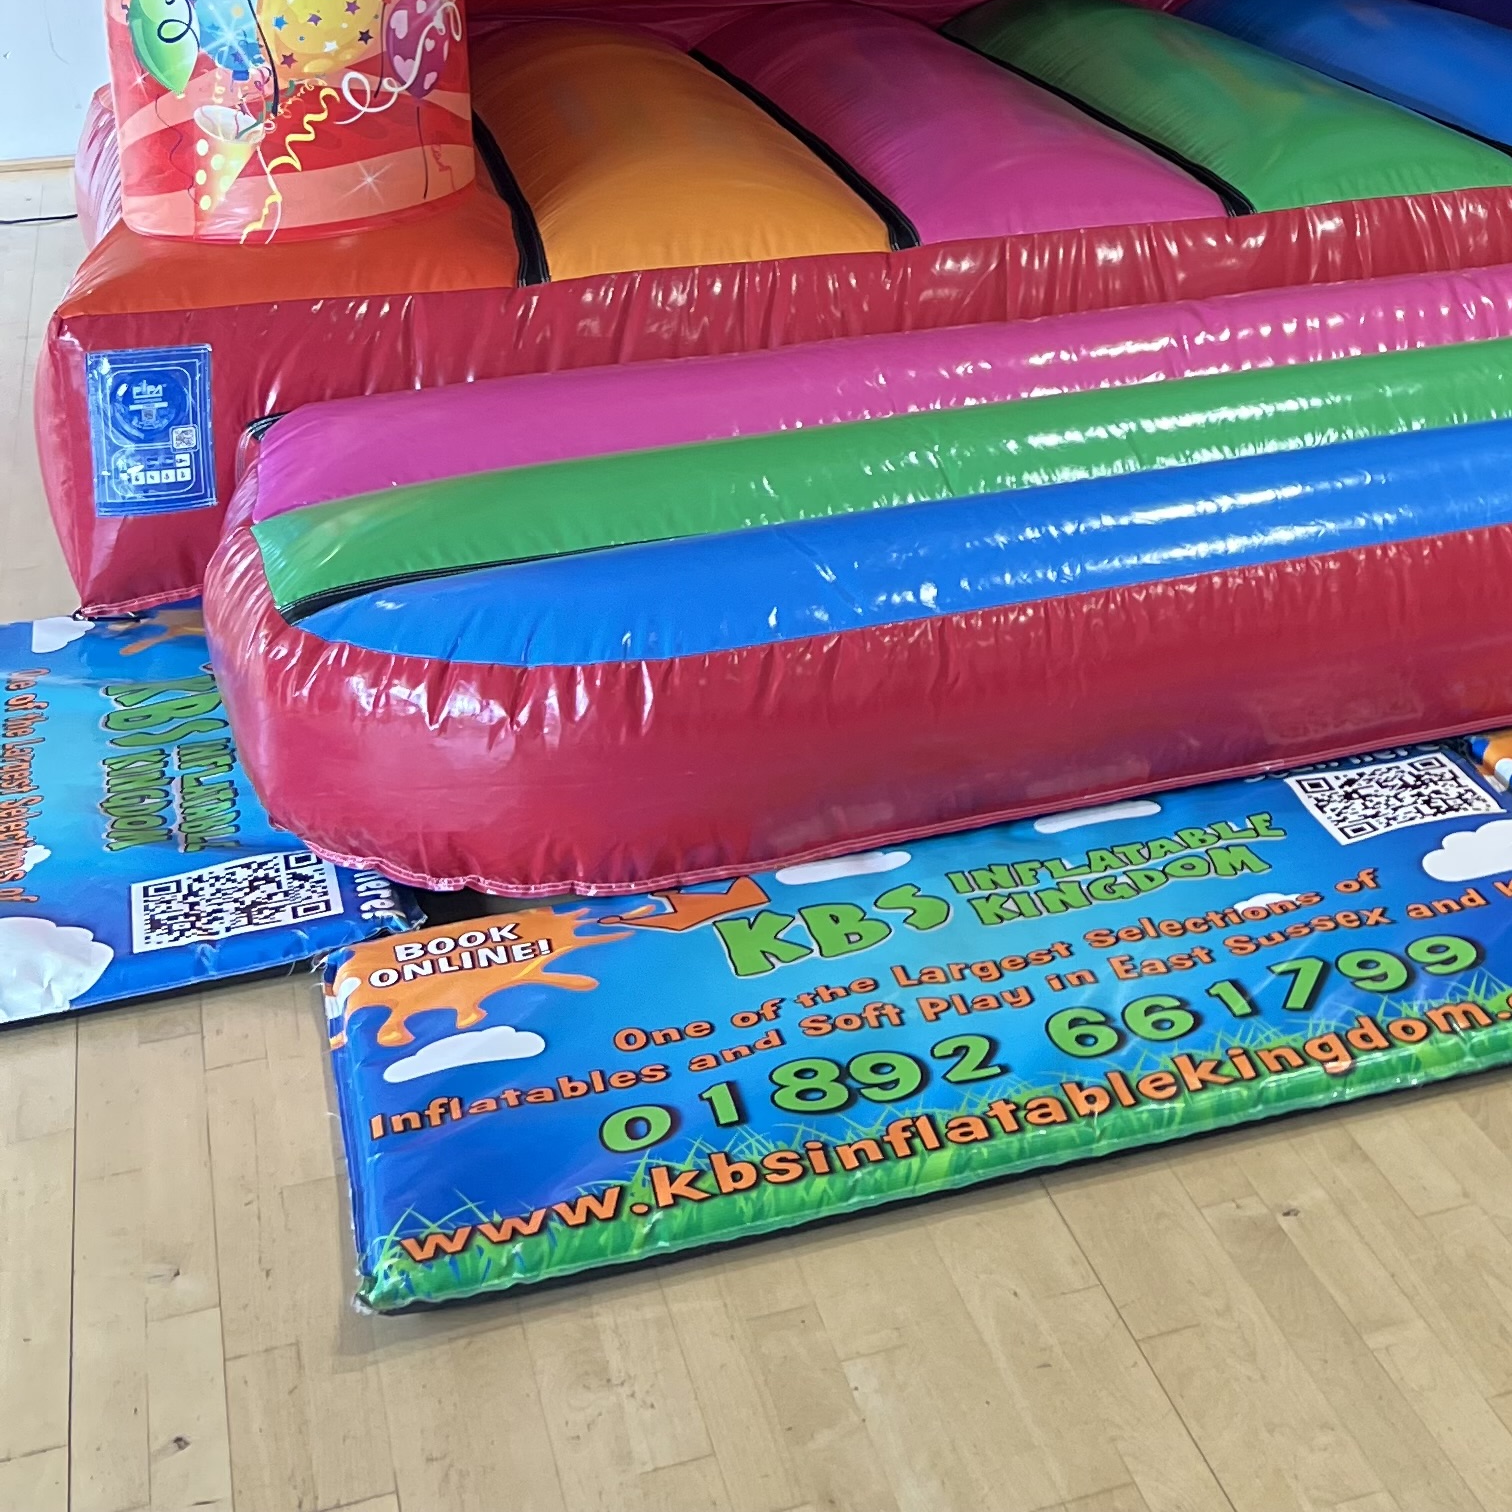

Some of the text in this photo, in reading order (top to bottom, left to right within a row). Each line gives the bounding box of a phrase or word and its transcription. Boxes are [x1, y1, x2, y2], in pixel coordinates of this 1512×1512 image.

[2, 712, 49, 738] the
[4, 693, 50, 712] of
[102, 674, 229, 748] KBS
[1, 737, 46, 795] Largest
[100, 748, 176, 852] KINGDOM
[0, 794, 45, 882] Selections
[947, 811, 1287, 895] INFLATABLE
[970, 843, 1273, 927] KINGDOM
[367, 937, 553, 989] ONLINE!
[393, 921, 521, 963] BOOK
[612, 867, 1381, 1055] One of the Largest Selections of
[714, 882, 953, 979] KBS
[369, 1061, 668, 1141] Inflatables
[688, 1030, 784, 1074] and
[801, 1003, 903, 1039] Soft
[920, 984, 1032, 1024] Play
[1048, 967, 1096, 989] in
[1107, 946, 1216, 981] East
[1223, 904, 1394, 956] Sussex
[1405, 889, 1489, 921] and
[597, 934, 1487, 1155] 01892 661799
